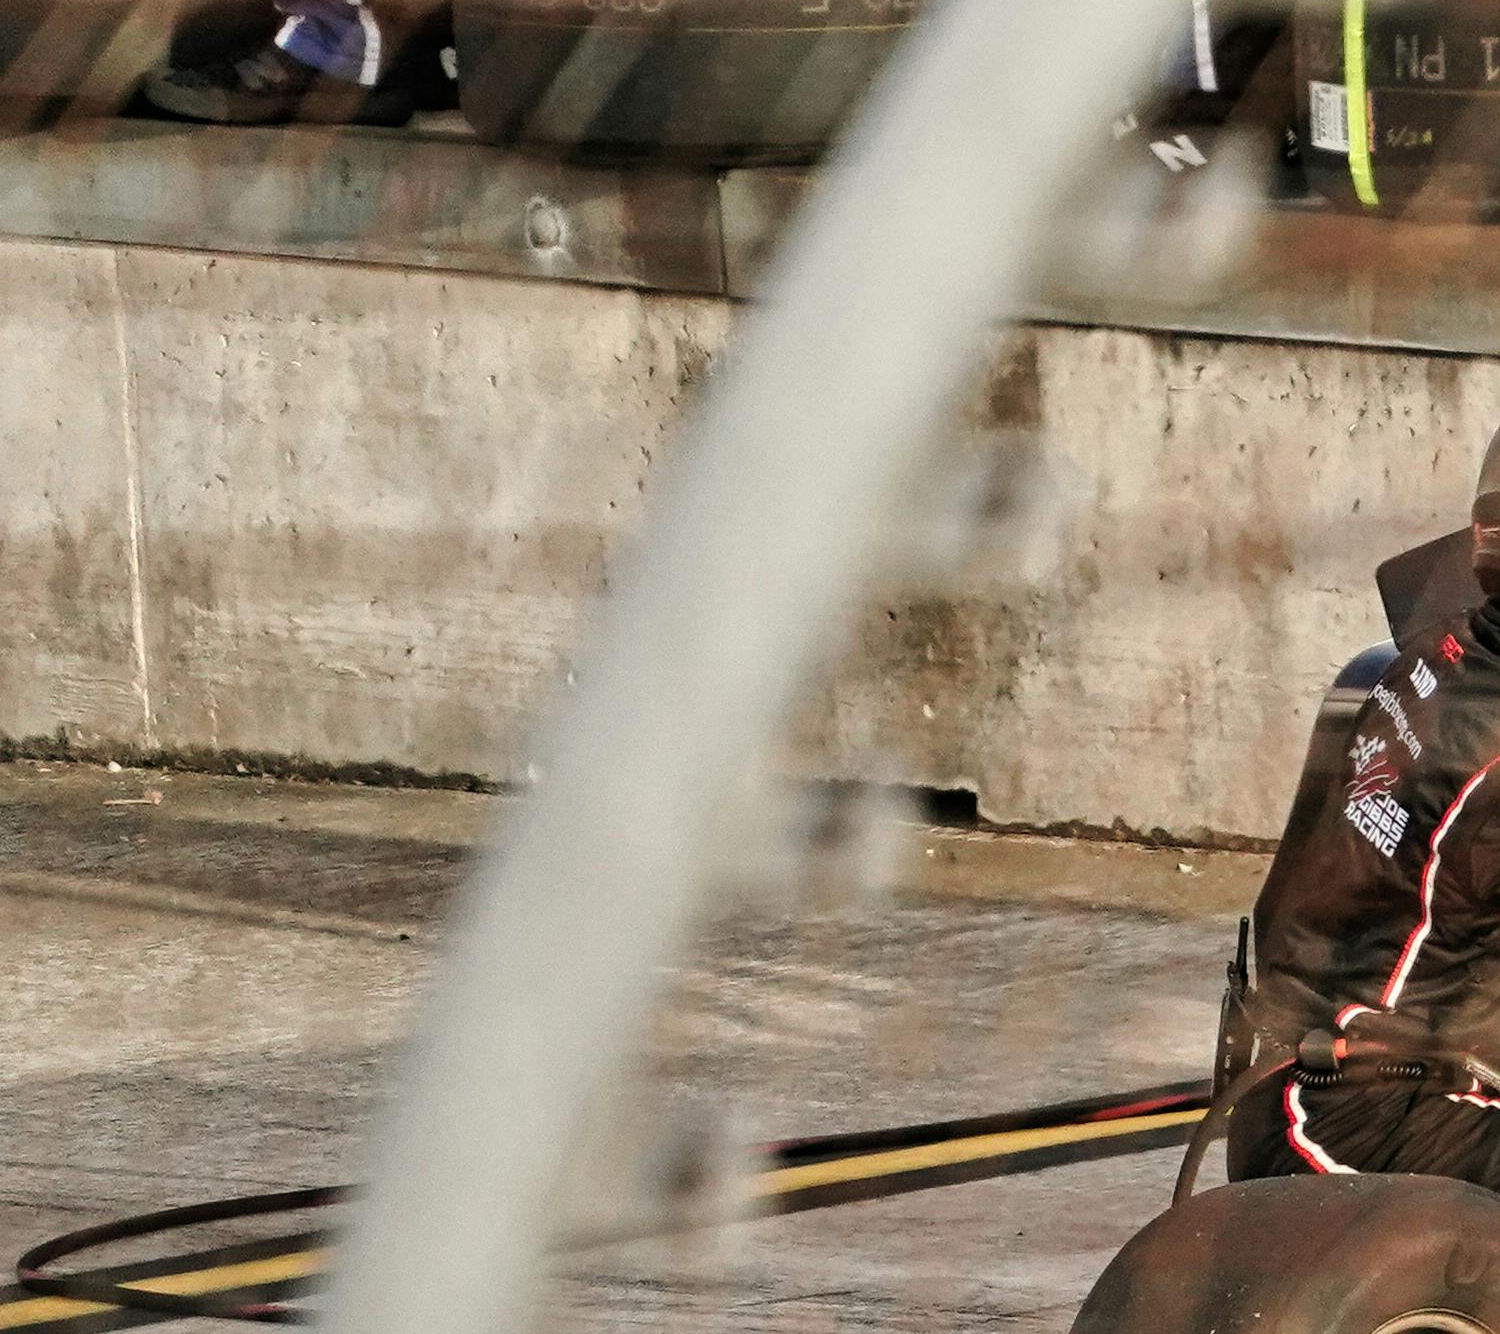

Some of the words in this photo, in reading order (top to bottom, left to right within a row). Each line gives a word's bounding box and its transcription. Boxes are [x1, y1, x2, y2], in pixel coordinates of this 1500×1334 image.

[1409, 657, 1438, 700] LIND
[1344, 800, 1398, 858] RACING
[1358, 795, 1405, 843] GIBBS
[1375, 793, 1410, 825] JOE
